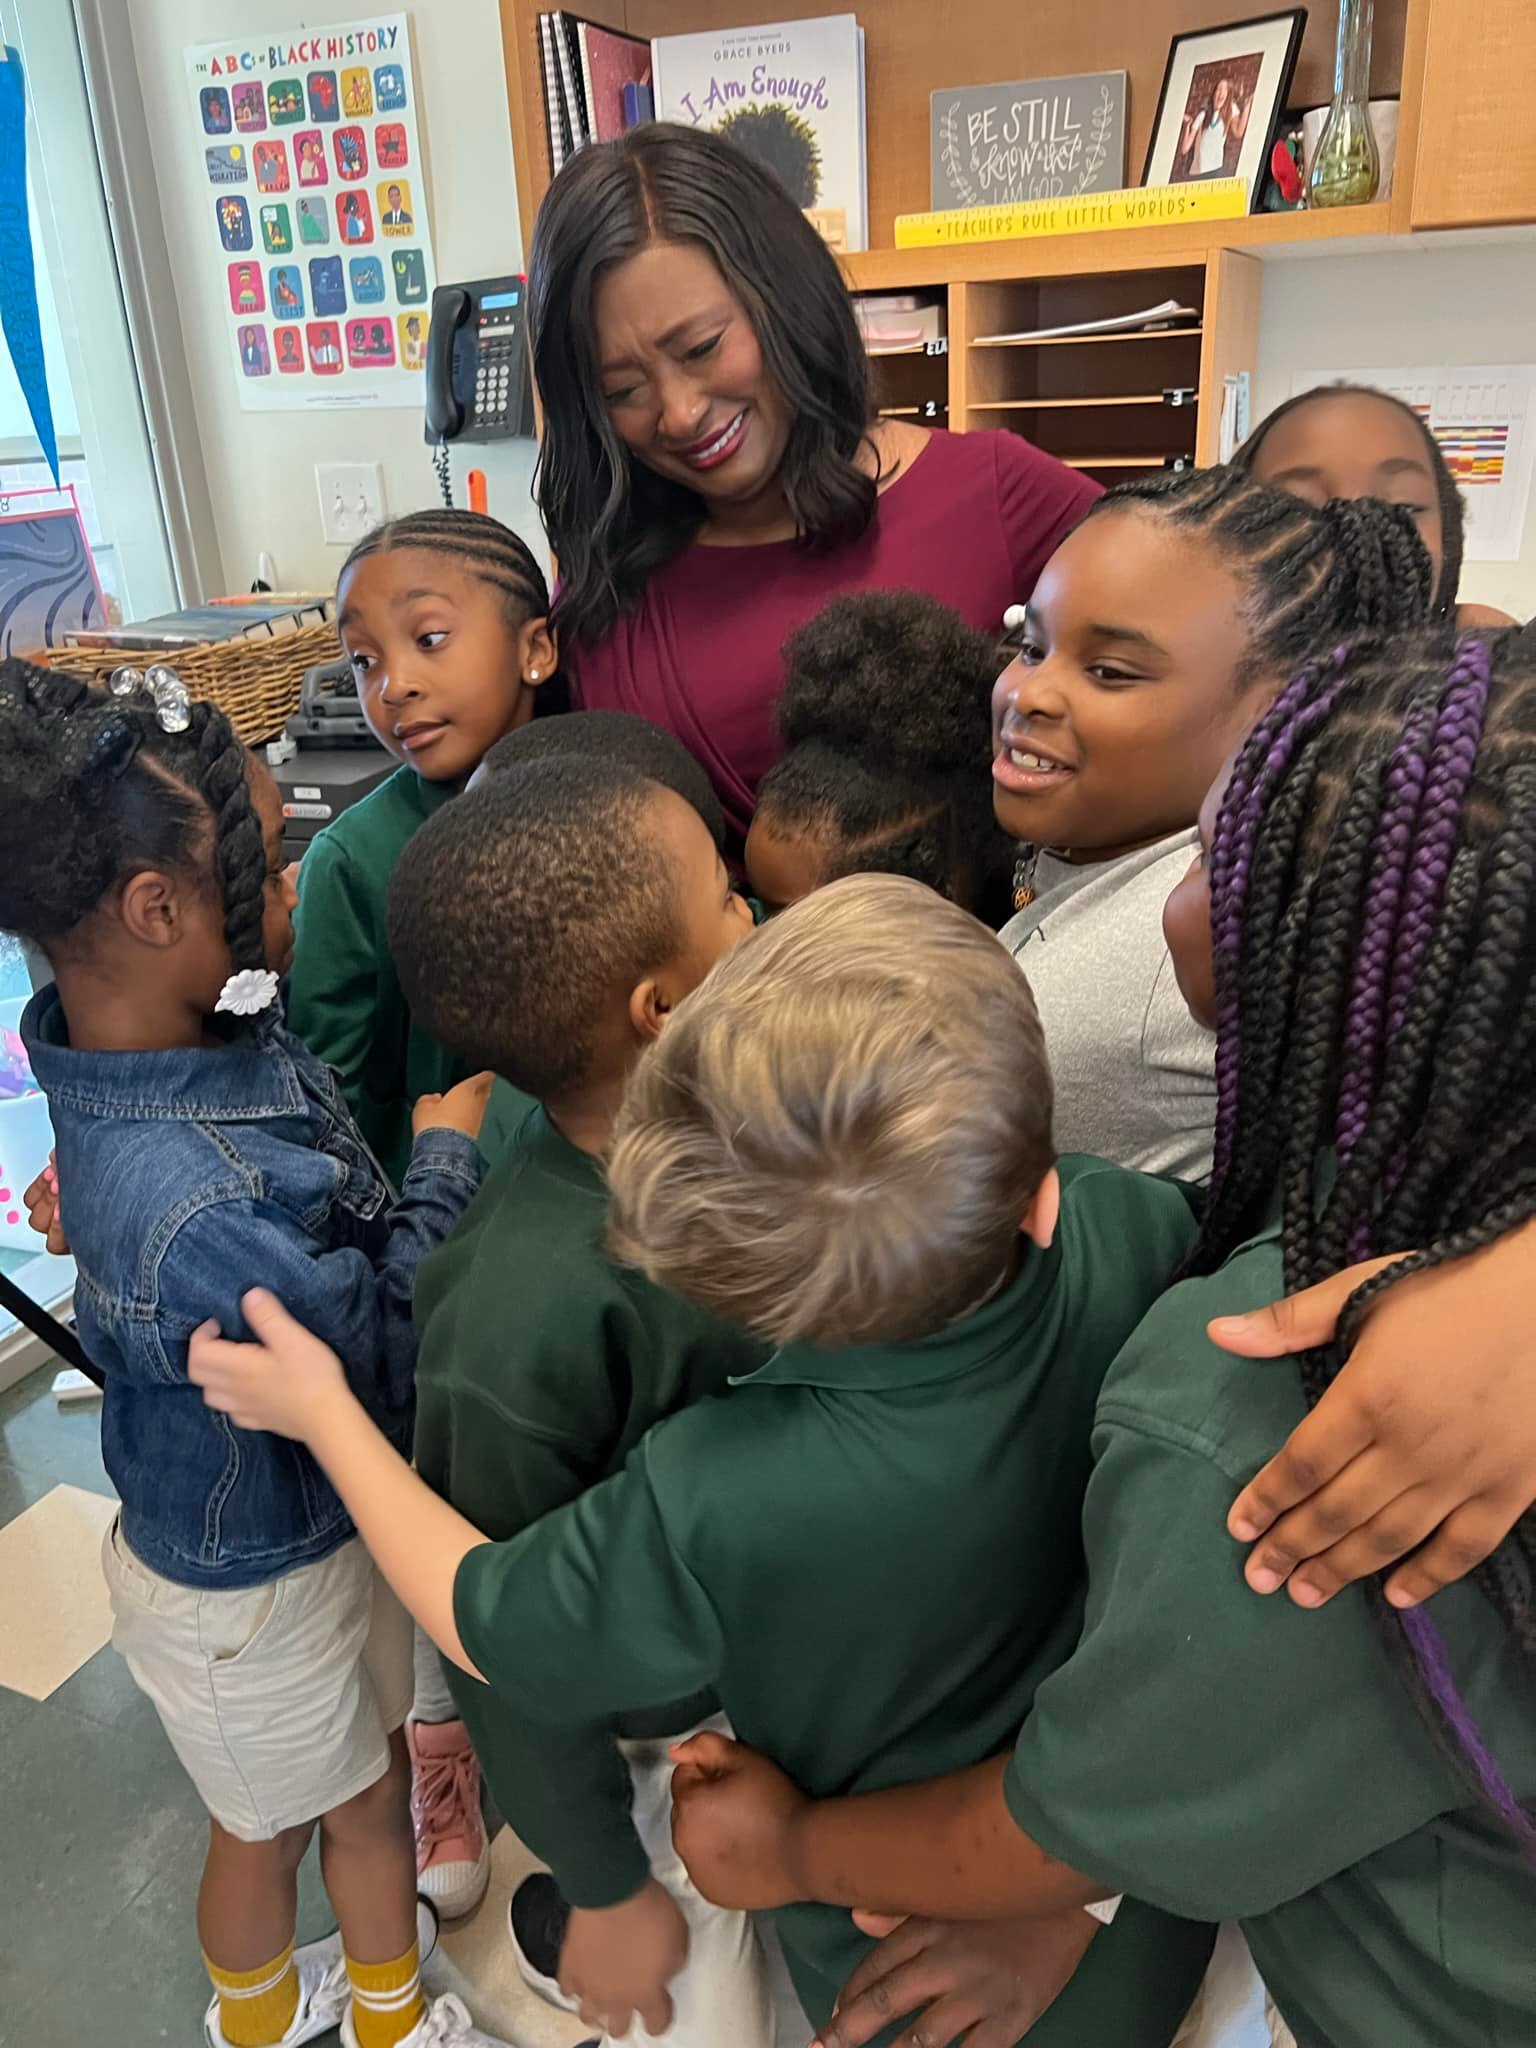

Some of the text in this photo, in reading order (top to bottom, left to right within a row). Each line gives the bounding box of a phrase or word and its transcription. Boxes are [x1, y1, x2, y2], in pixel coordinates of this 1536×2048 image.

[268, 38, 321, 69] BLACK
[327, 25, 398, 59] HISTORY
[714, 42, 792, 61] GRACE BYERS
[681, 64, 829, 124] I Am Enough
[967, 95, 1081, 146] BE STILL
[948, 197, 1185, 238] TEACHERS RULE LITTLE WORLDS
[925, 401, 936, 416] 2
[1171, 390, 1183, 406] 3
